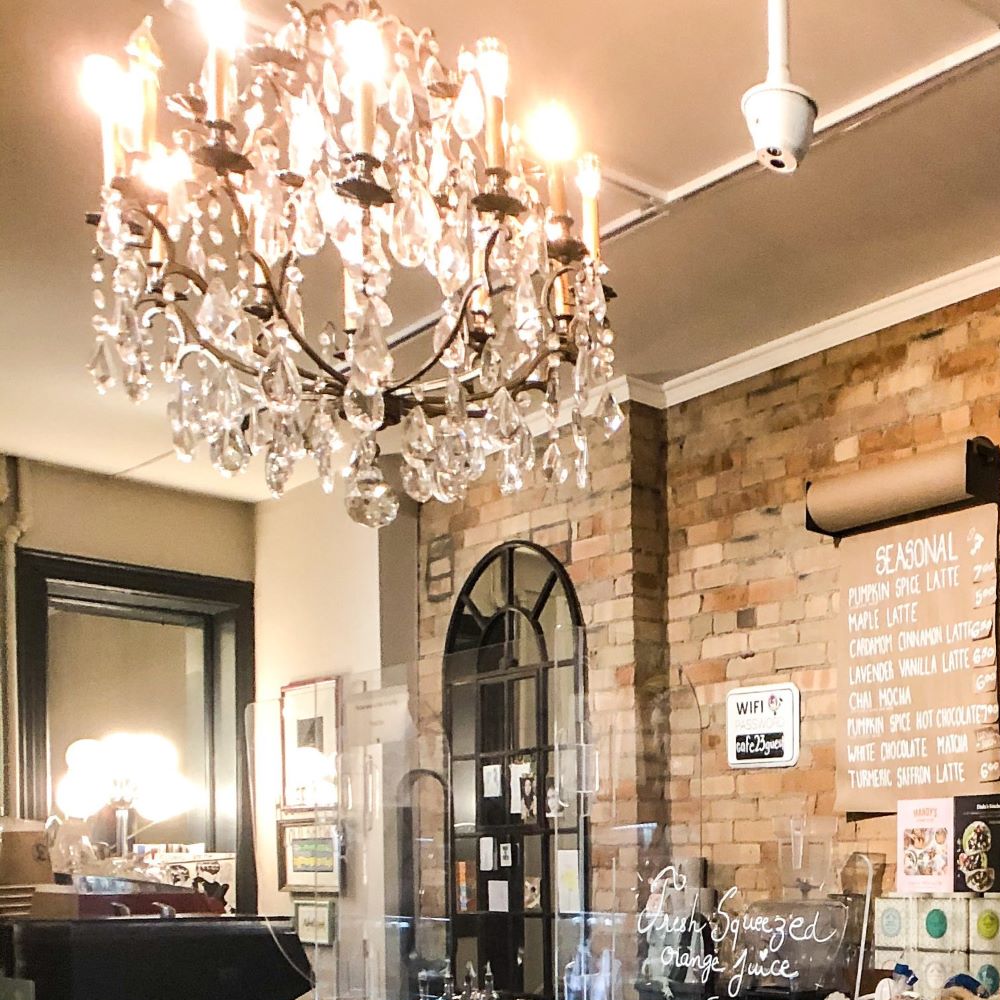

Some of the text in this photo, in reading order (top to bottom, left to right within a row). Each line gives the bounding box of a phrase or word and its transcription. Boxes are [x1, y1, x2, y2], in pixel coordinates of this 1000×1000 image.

[875, 530, 959, 576] SEASONAL
[848, 580, 890, 607] PUMPKIN
[895, 574, 922, 599] SPICE
[926, 564, 961, 592] LATTE
[847, 609, 880, 633] MAPLE
[886, 601, 919, 628] LATTE
[848, 660, 895, 686] LAVENDER
[898, 653, 938, 678] VANILLA
[942, 647, 970, 673] LATTE
[736, 700, 764, 715] WIFI
[848, 690, 873, 711] CHAI
[878, 685, 912, 708] MOCHA
[847, 715, 885, 738] PUMPKIN
[889, 711, 912, 733] SPICE
[916, 708, 934, 730] HOT
[847, 742, 876, 763] WHITE
[880, 737, 929, 762] CHOCOLATE
[936, 733, 969, 756] MATCHA
[847, 768, 893, 789] TURMERIC
[896, 764, 932, 789] SAFFRON
[936, 762, 966, 784] LATTE
[711, 886, 837, 952] Squeezed
